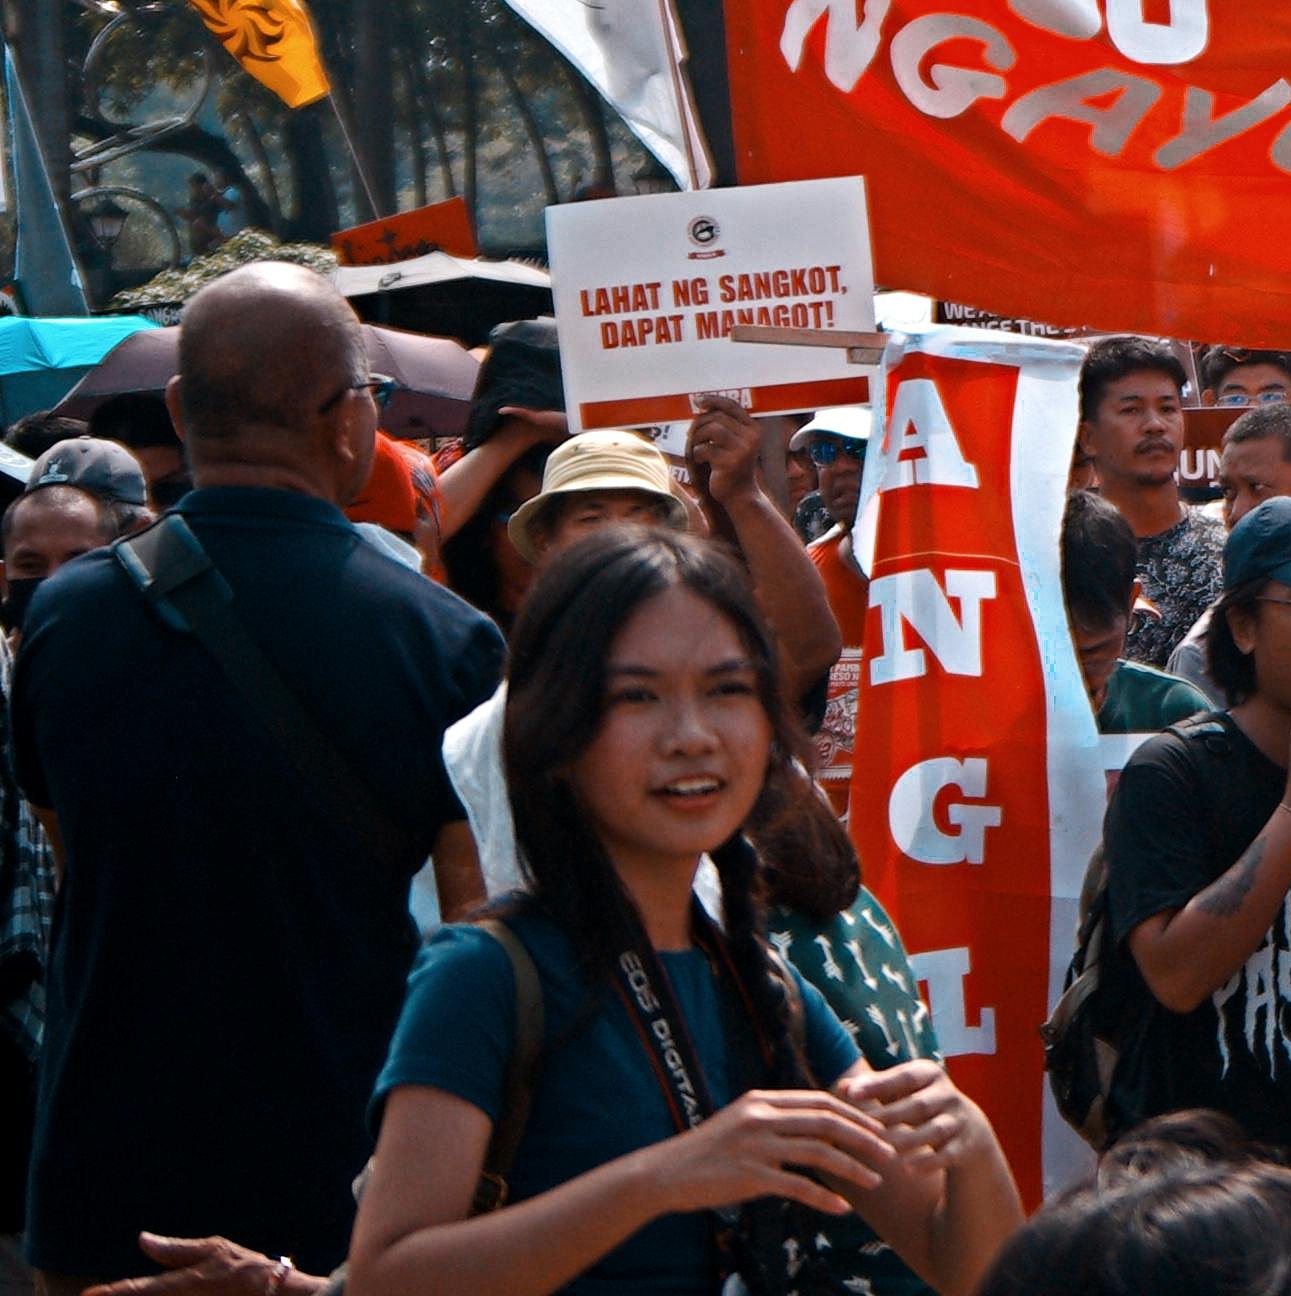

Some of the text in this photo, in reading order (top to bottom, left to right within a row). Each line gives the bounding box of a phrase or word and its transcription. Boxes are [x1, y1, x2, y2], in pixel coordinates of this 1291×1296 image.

[580, 265, 848, 317] LAHAT NG SANGKOT,
[601, 299, 835, 350] DAPAT MANAGOT!
[619, 950, 662, 1014] EOS
